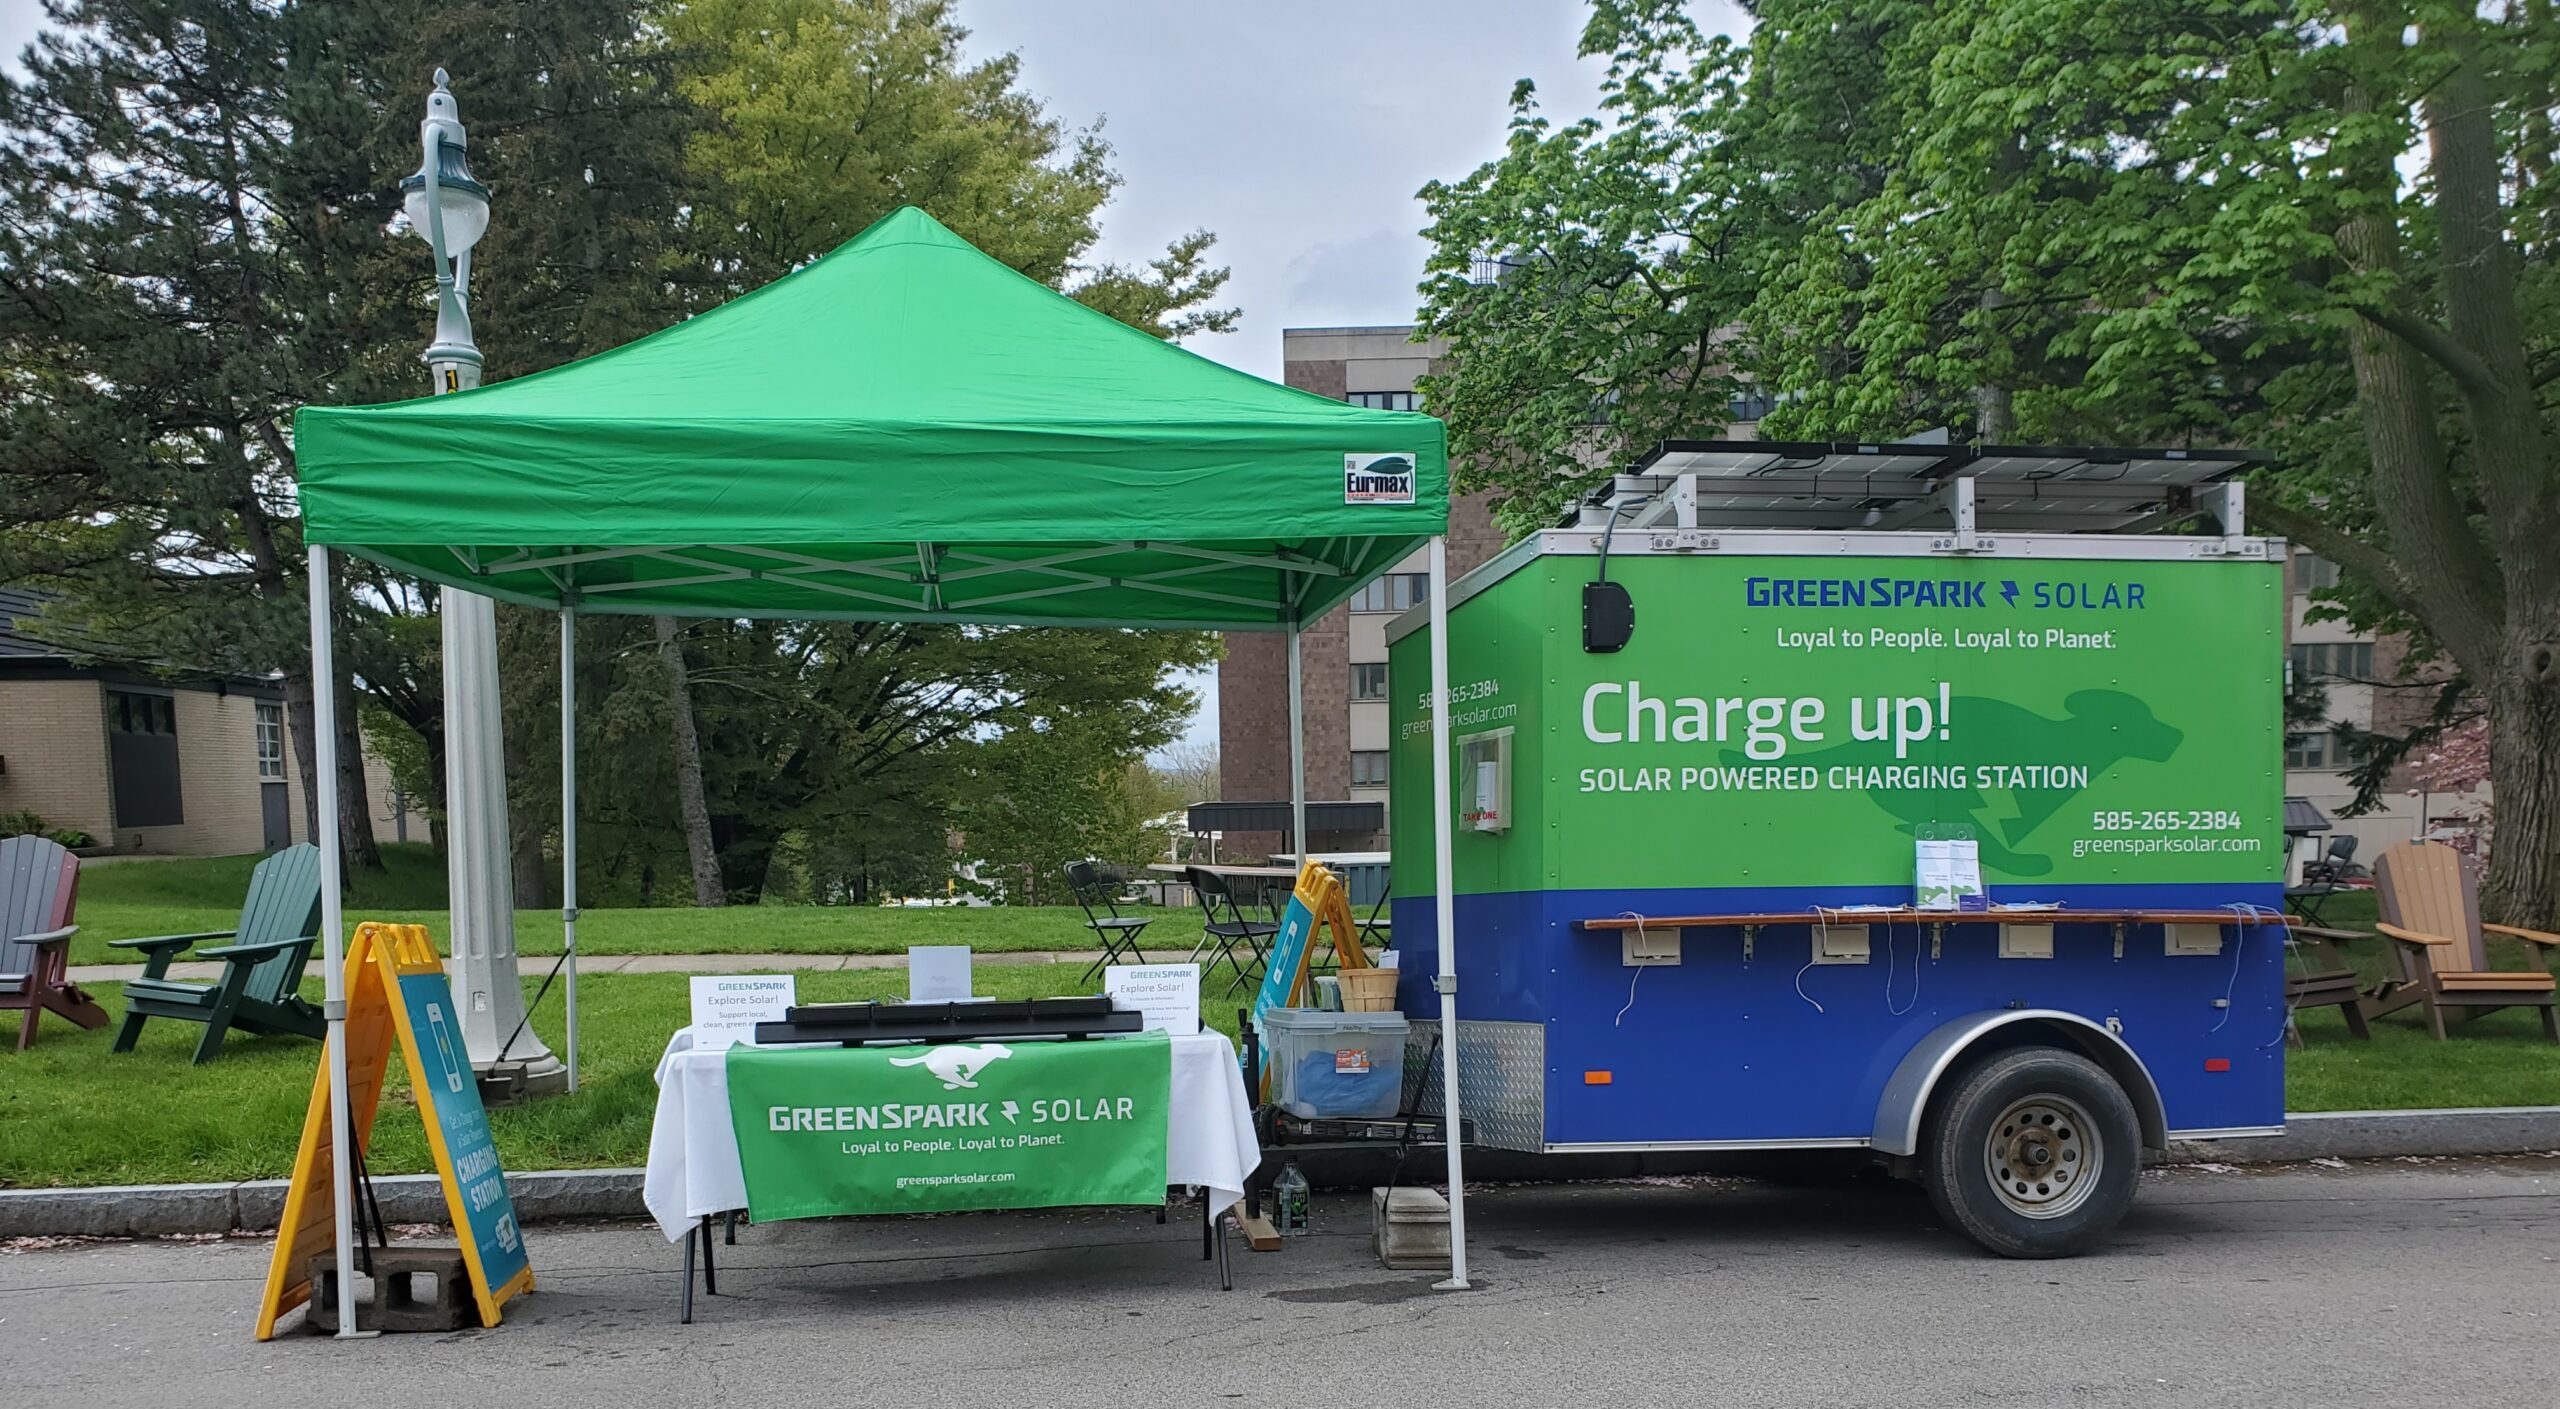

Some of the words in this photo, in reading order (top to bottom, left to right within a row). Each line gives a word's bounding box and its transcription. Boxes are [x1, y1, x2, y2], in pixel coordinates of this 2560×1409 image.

[1347, 472, 1409, 493] Eurmax
[1746, 577, 1986, 607] GREENSPARK
[2034, 582, 2145, 609] SOLAR
[1777, 627, 1835, 653] Loyal
[1842, 630, 1864, 648] to
[1870, 628, 1948, 653] People.
[1954, 628, 2011, 653] Loyal
[2018, 630, 2039, 649] to
[2045, 628, 2117, 649] Planet.
[1418, 678, 1499, 710] 58265-2384
[1401, 703, 1517, 741] greenarksolar.com
[1581, 681, 1825, 761] Charge
[1850, 682, 1950, 759] up!
[1579, 768, 1672, 793] SOLAR
[1681, 767, 1819, 792] POWERED
[1828, 766, 1967, 790] CHARGING
[1976, 765, 2088, 790] STATION
[1463, 812, 1481, 822] TAKE
[1482, 811, 1498, 821] ONE
[2093, 811, 2242, 831] 585-265-2384
[2072, 835, 2261, 858] greensparksolar.com
[718, 982, 786, 991] GREENSPARK
[1120, 984, 1155, 994] Explore
[1157, 983, 1184, 992] Solar!
[708, 996, 747, 1007] Explore
[749, 995, 778, 1005] Solar!
[703, 1021, 725, 1029] clean,
[719, 1011, 747, 1020] Support
[749, 1010, 768, 1018] local,
[769, 1103, 990, 1131] GREENSPARK
[1032, 1097, 1134, 1123] SOLAR
[842, 1141, 881, 1156] Loyal
[884, 1141, 899, 1153] to
[903, 1138, 955, 1155] People.
[959, 1136, 997, 1153] Loyal
[1000, 1137, 1015, 1148] to
[1019, 1133, 1065, 1147] Planet.
[457, 1143, 498, 1184] CHARGING
[896, 1171, 1016, 1189] greensparksolar.com
[470, 1175, 503, 1213] STATION
